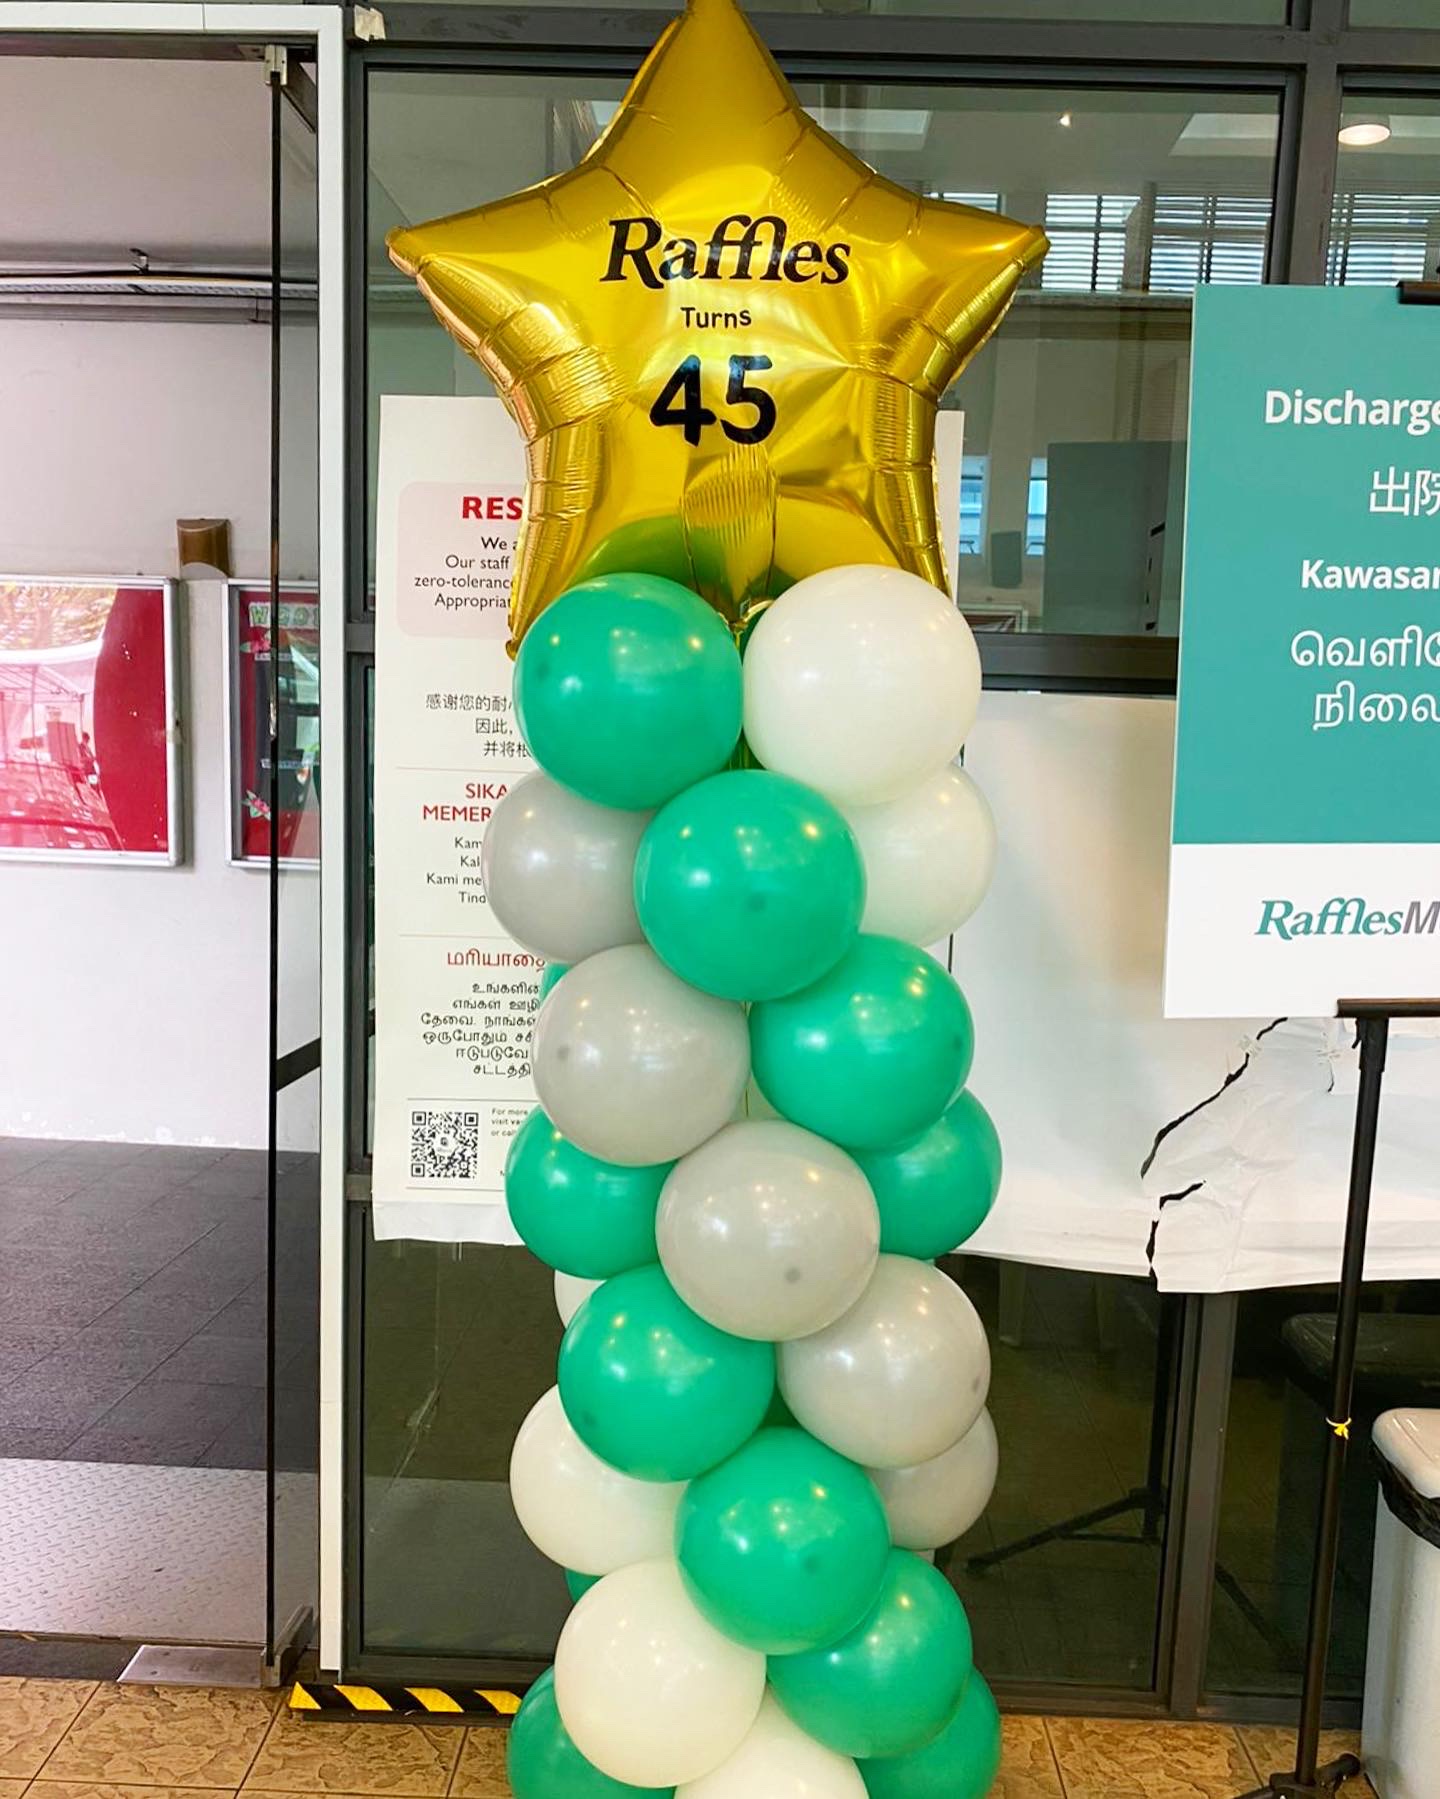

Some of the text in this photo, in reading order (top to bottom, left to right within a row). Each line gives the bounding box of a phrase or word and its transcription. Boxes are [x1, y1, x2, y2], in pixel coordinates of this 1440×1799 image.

[600, 214, 851, 289] Raffles
[681, 307, 752, 329] Turns
[649, 354, 777, 447] 45
[462, 496, 523, 520] RES
[481, 536, 507, 550] We
[445, 555, 510, 570] Our staff
[426, 693, 513, 712] 感谢您的耐
[465, 783, 508, 800] SIKA
[422, 805, 492, 822] MEMER
[426, 873, 458, 885] Kami
